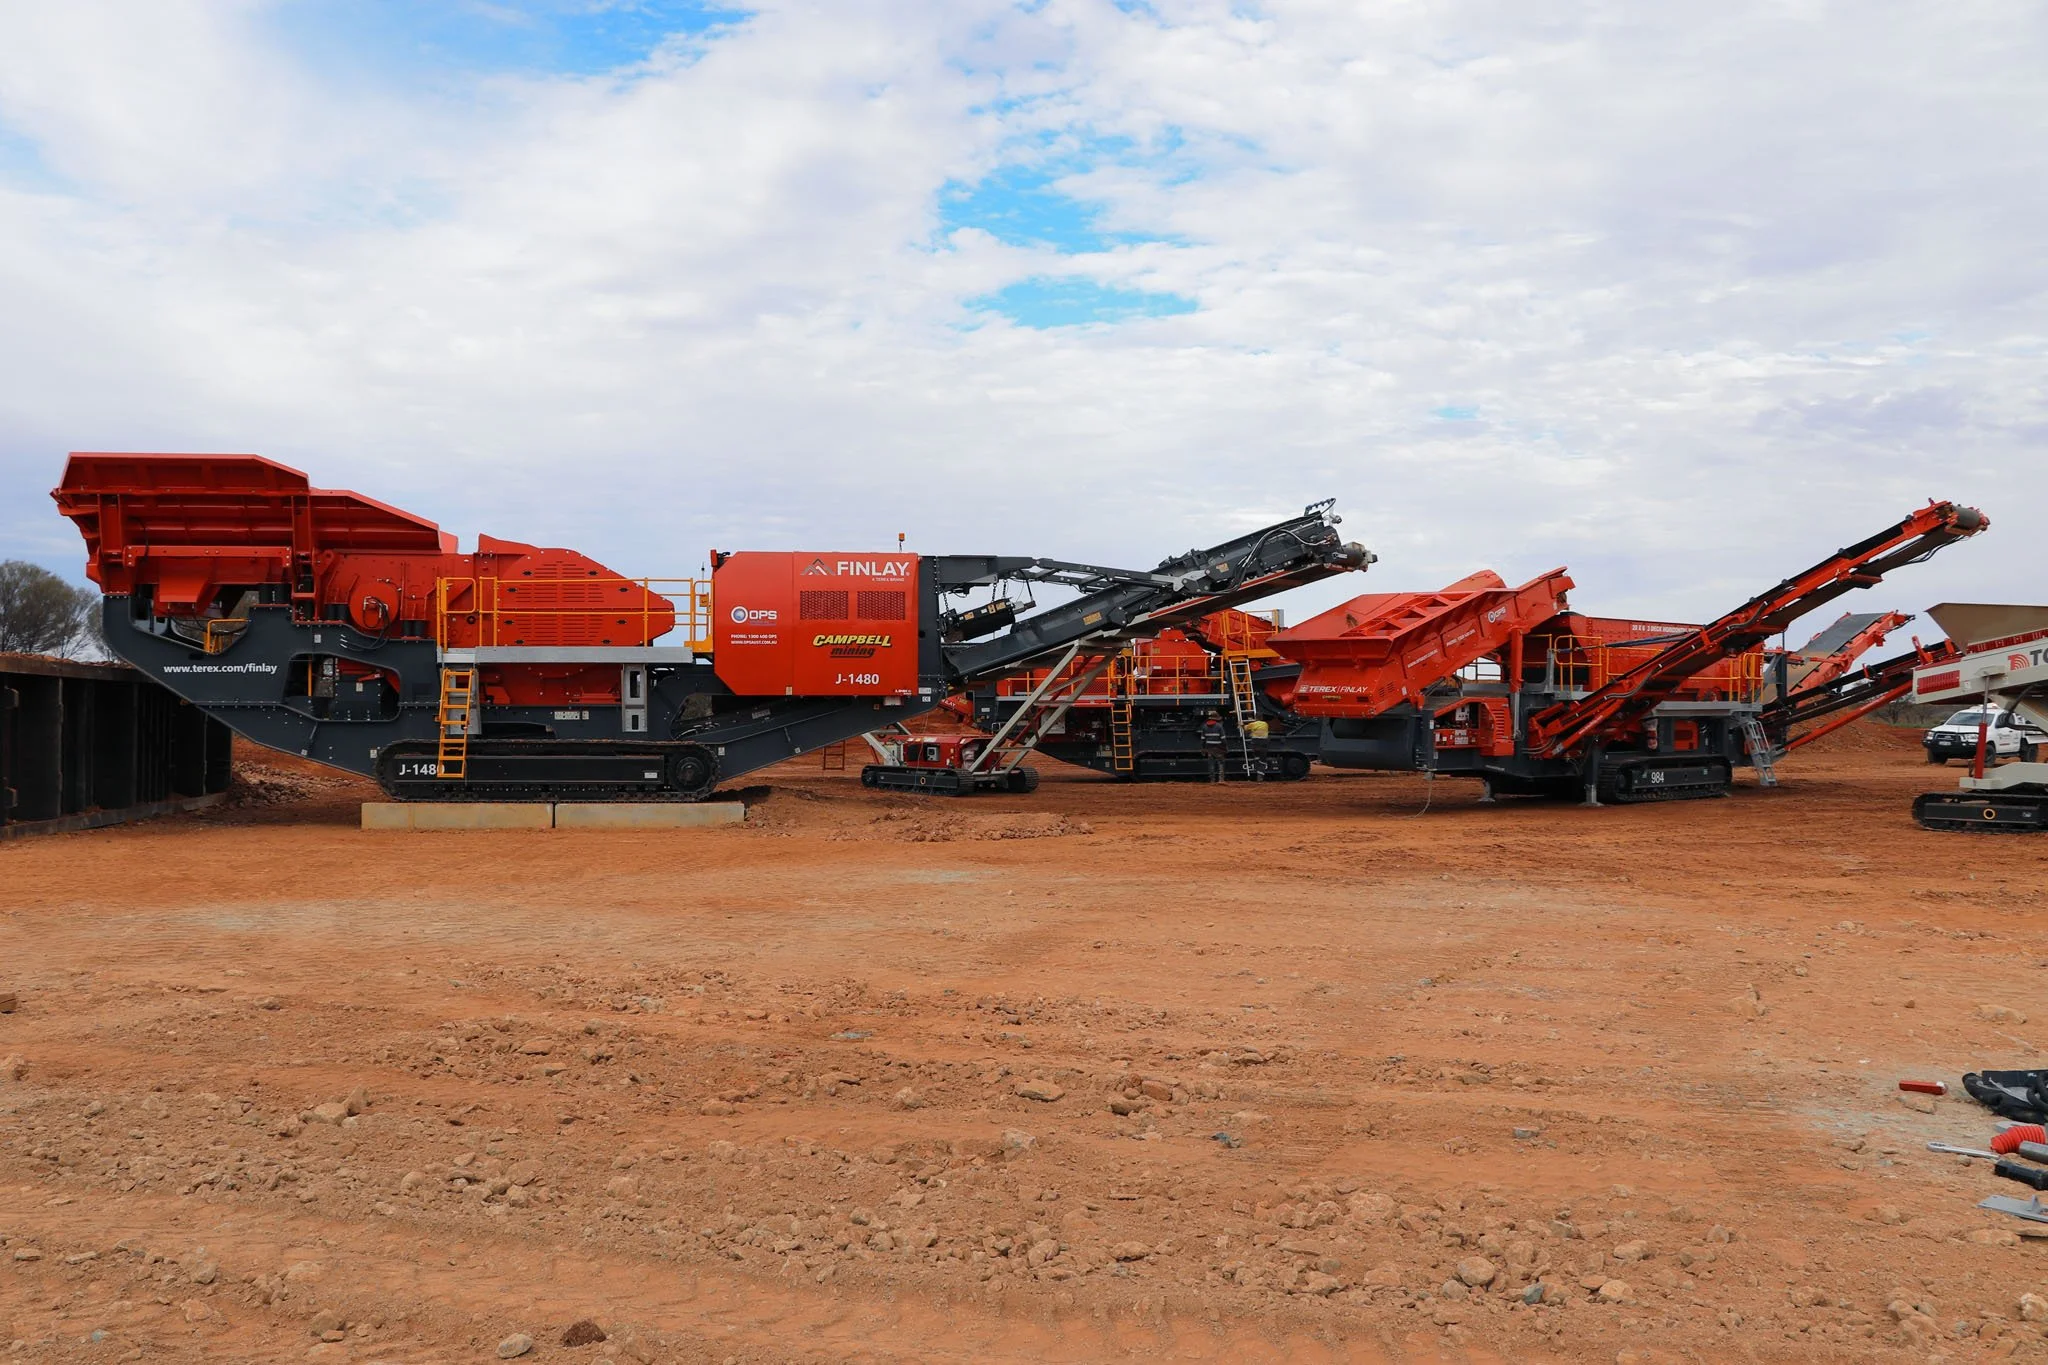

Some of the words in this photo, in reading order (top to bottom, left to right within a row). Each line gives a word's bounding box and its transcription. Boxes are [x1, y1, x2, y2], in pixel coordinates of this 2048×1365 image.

[837, 561, 909, 576] FINLAY
[749, 610, 777, 620] OPS
[812, 634, 892, 648] CAMPBELL
[831, 645, 876, 657] mining
[163, 663, 277, 674] www.terex.com/finlay
[835, 673, 880, 685] J-1480
[1651, 771, 1665, 784] 984
